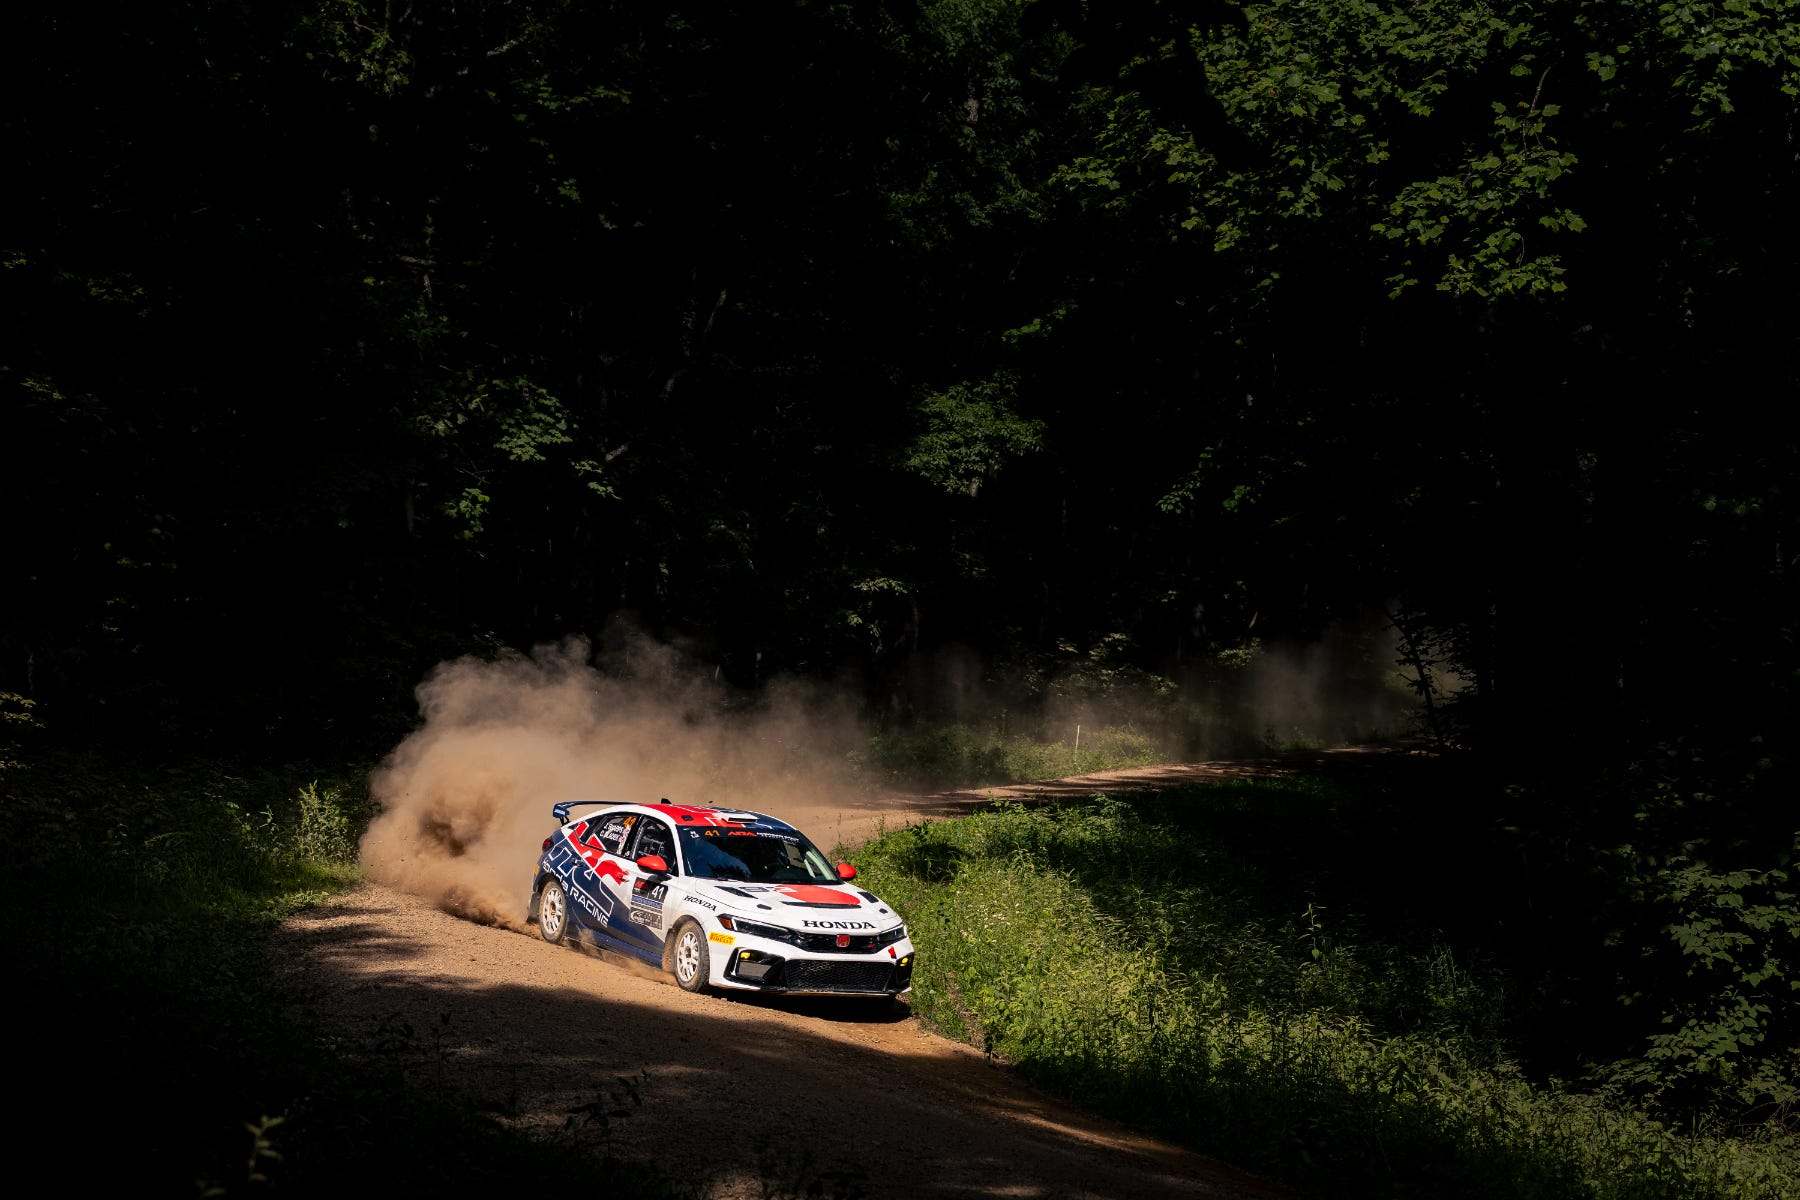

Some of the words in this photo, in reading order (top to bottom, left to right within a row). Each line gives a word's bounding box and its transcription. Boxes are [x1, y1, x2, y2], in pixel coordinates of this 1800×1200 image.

[705, 829, 720, 837] 41
[651, 885, 665, 900] 41
[570, 886, 609, 928] RACING
[683, 895, 717, 911] HONDA
[801, 919, 877, 929] HONDA
